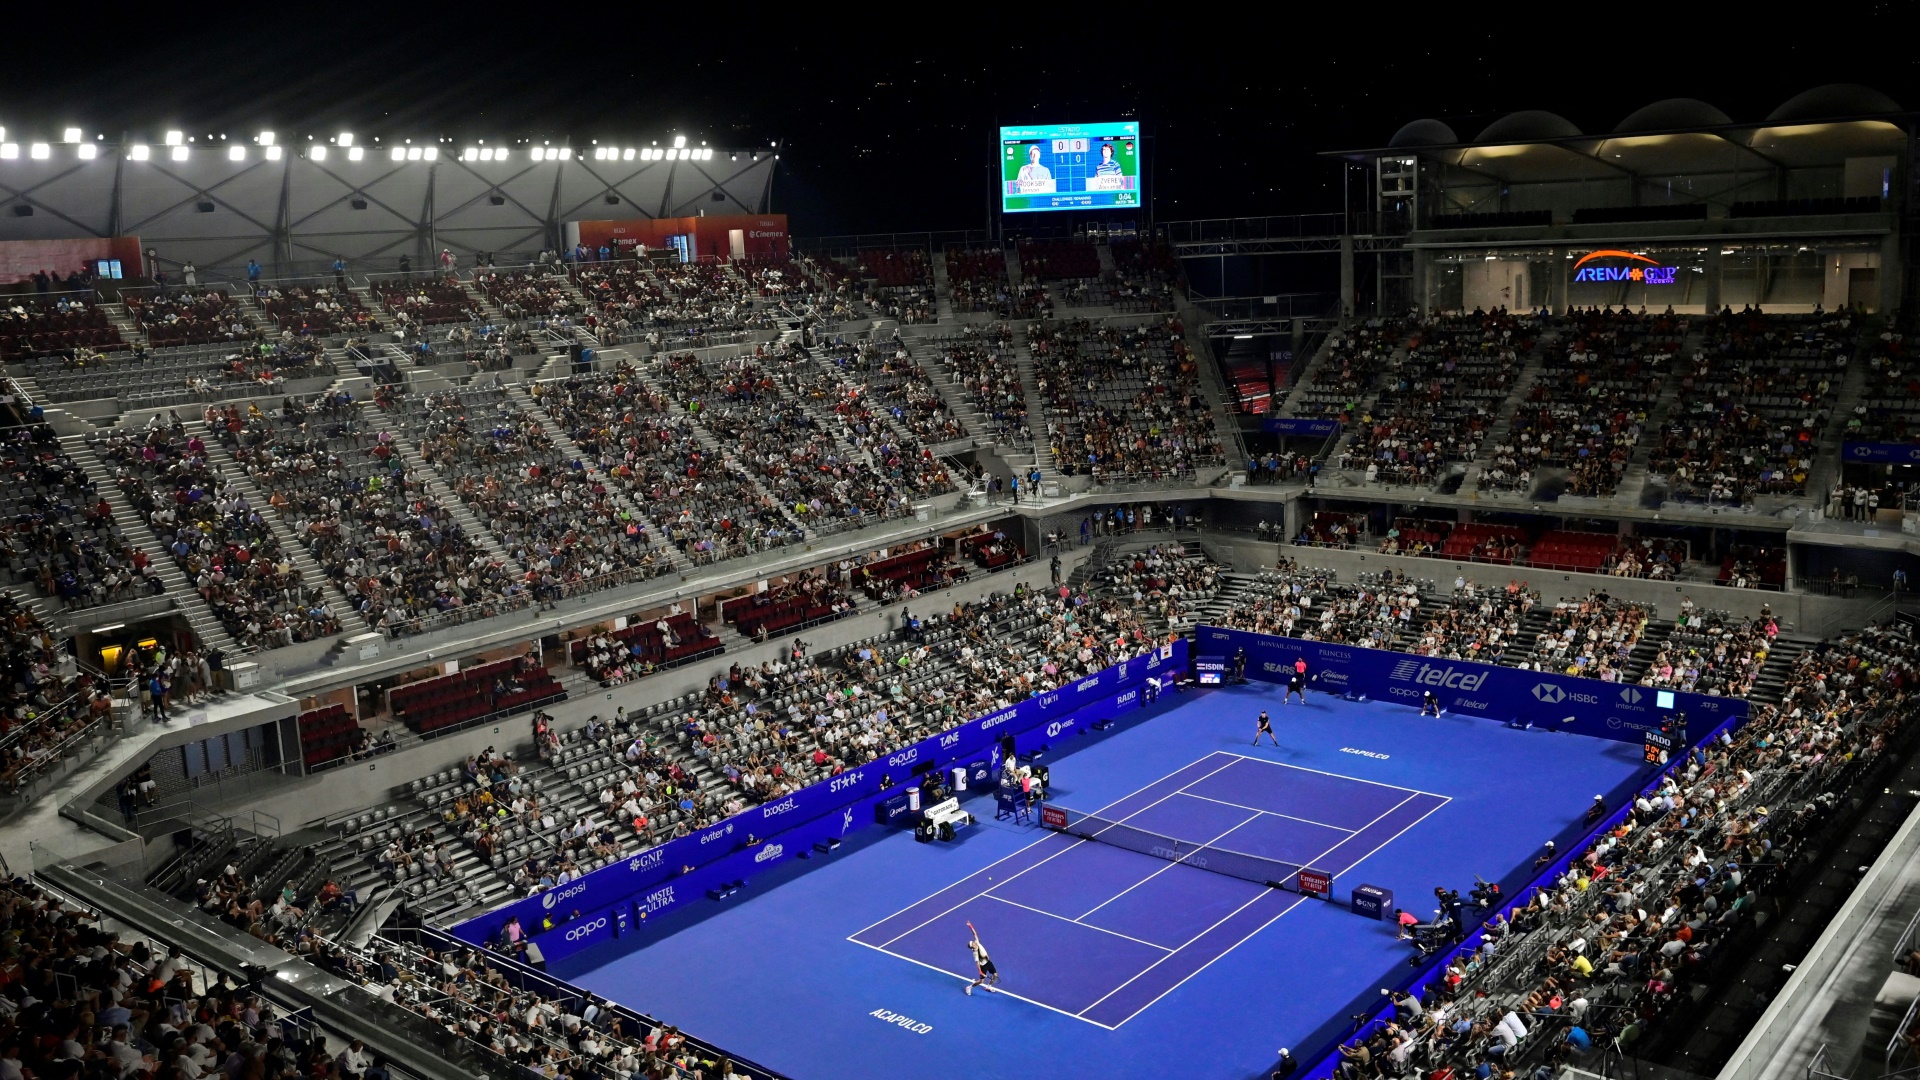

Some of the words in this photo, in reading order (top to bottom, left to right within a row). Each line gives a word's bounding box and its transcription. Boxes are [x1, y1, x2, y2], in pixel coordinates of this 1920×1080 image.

[1575, 267, 1630, 281] ARENA
[1644, 267, 1676, 279] GNP
[1319, 649, 1351, 659] PRINCESS
[1263, 662, 1295, 675] SEARS
[1415, 663, 1489, 692] telcel
[1117, 690, 1136, 704] RADO
[1389, 687, 1419, 698] oppo
[1569, 692, 1598, 705] HSBC
[1463, 699, 1488, 710] telcel
[1616, 702, 1645, 712] inter.mx
[981, 709, 1017, 730] GATORADE
[1062, 718, 1074, 729] HSBC
[1646, 732, 1670, 746] RADO
[1339, 747, 1390, 759] ACAPULCO
[1044, 810, 1064, 819] Emirates
[701, 827, 725, 845] éviter
[640, 849, 663, 867] GNP
[1300, 875, 1326, 885] Emirates
[557, 881, 586, 903] pepsi
[646, 885, 675, 904] AMSTEL
[647, 894, 675, 913] ULTRA
[566, 917, 606, 941] oppo
[869, 1008, 933, 1034] ACAPULCO
